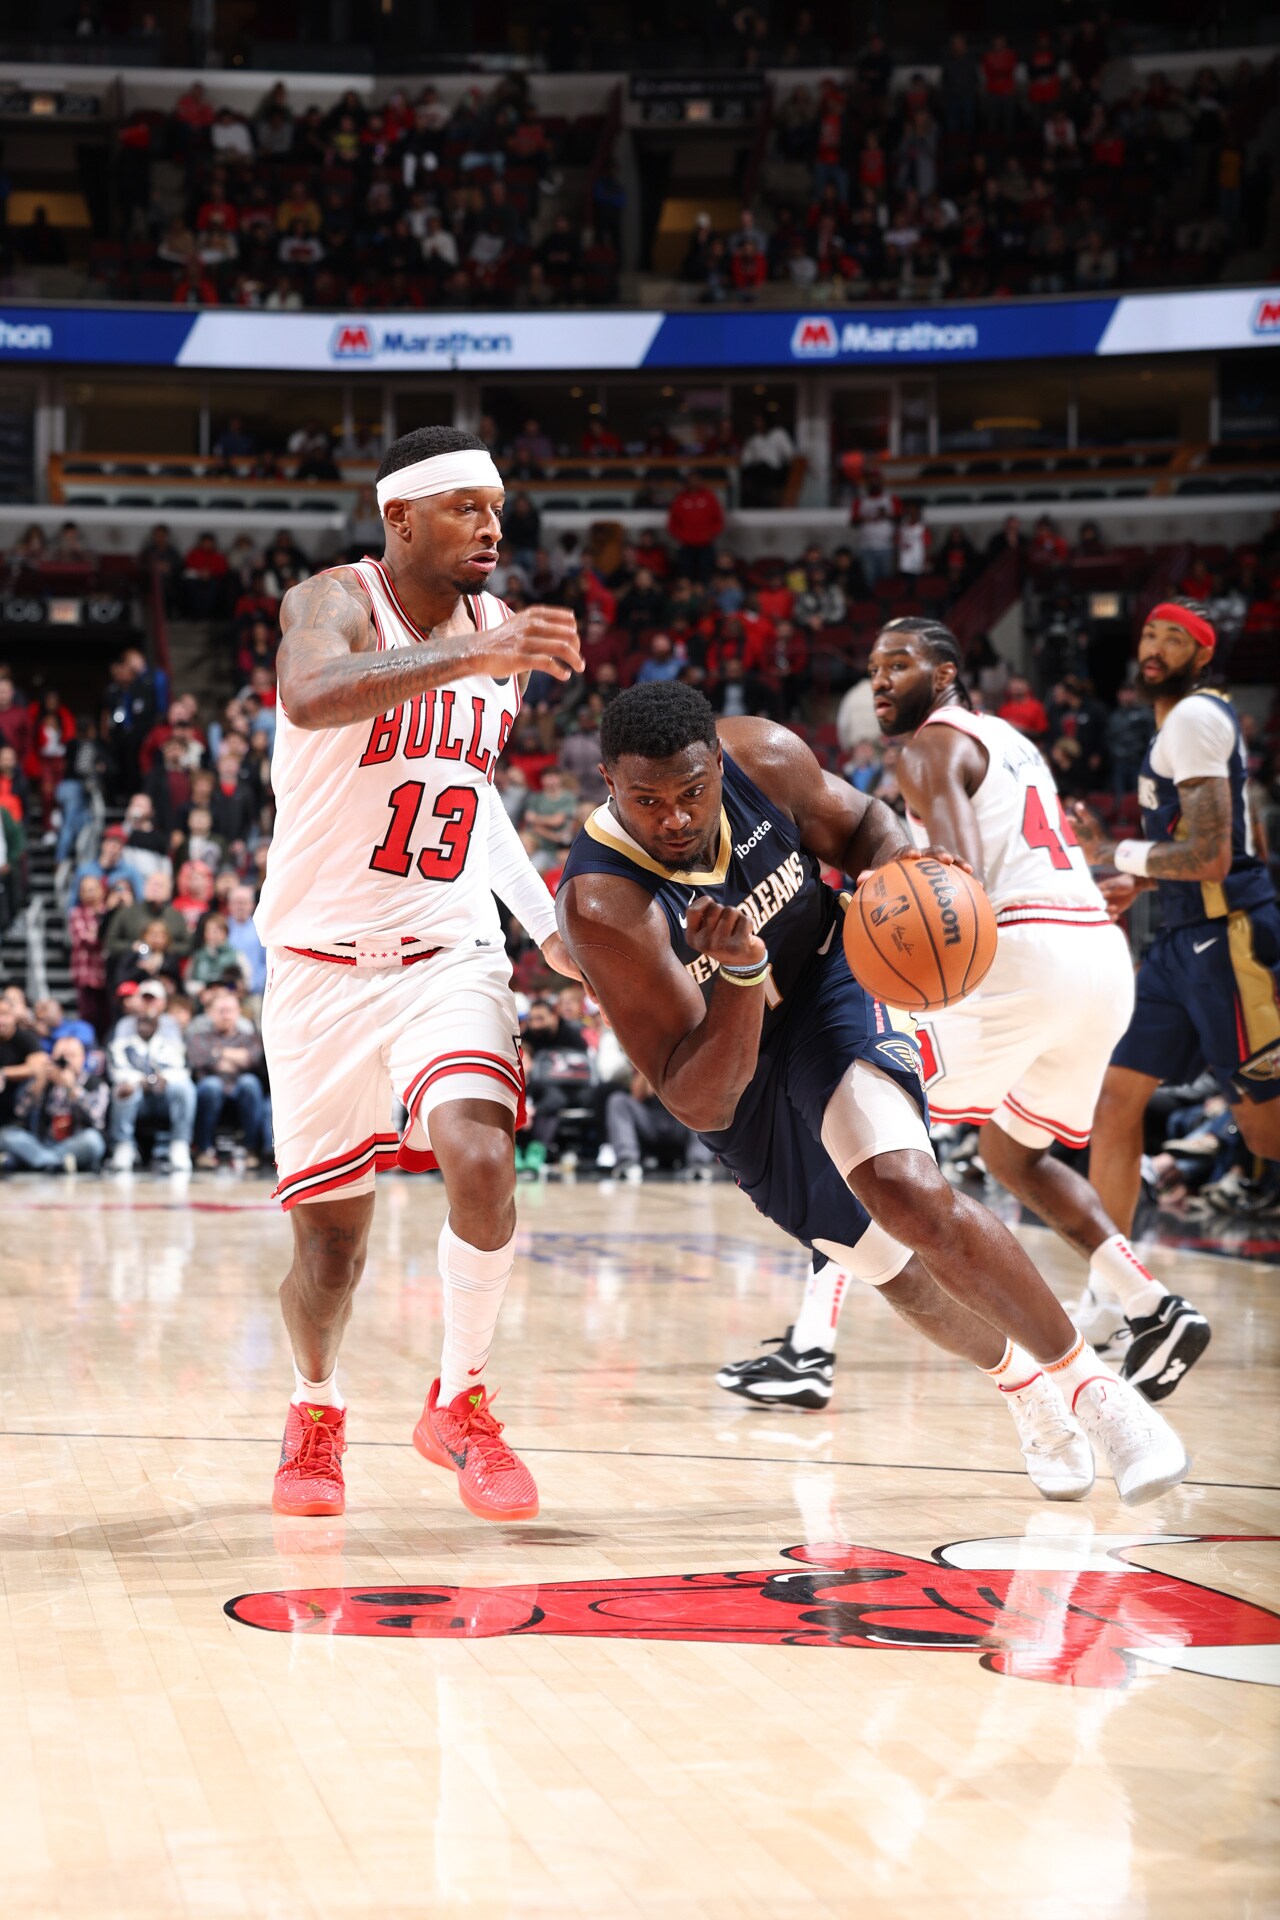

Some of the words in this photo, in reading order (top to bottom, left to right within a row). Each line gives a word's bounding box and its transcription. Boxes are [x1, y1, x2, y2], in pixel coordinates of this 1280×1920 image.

[381, 330, 512, 354] Marathon
[840, 322, 978, 353] Marathon
[359, 689, 513, 786] BULLS
[368, 779, 480, 883] 13
[733, 820, 773, 860] ibotta
[914, 859, 961, 949] Wilson
